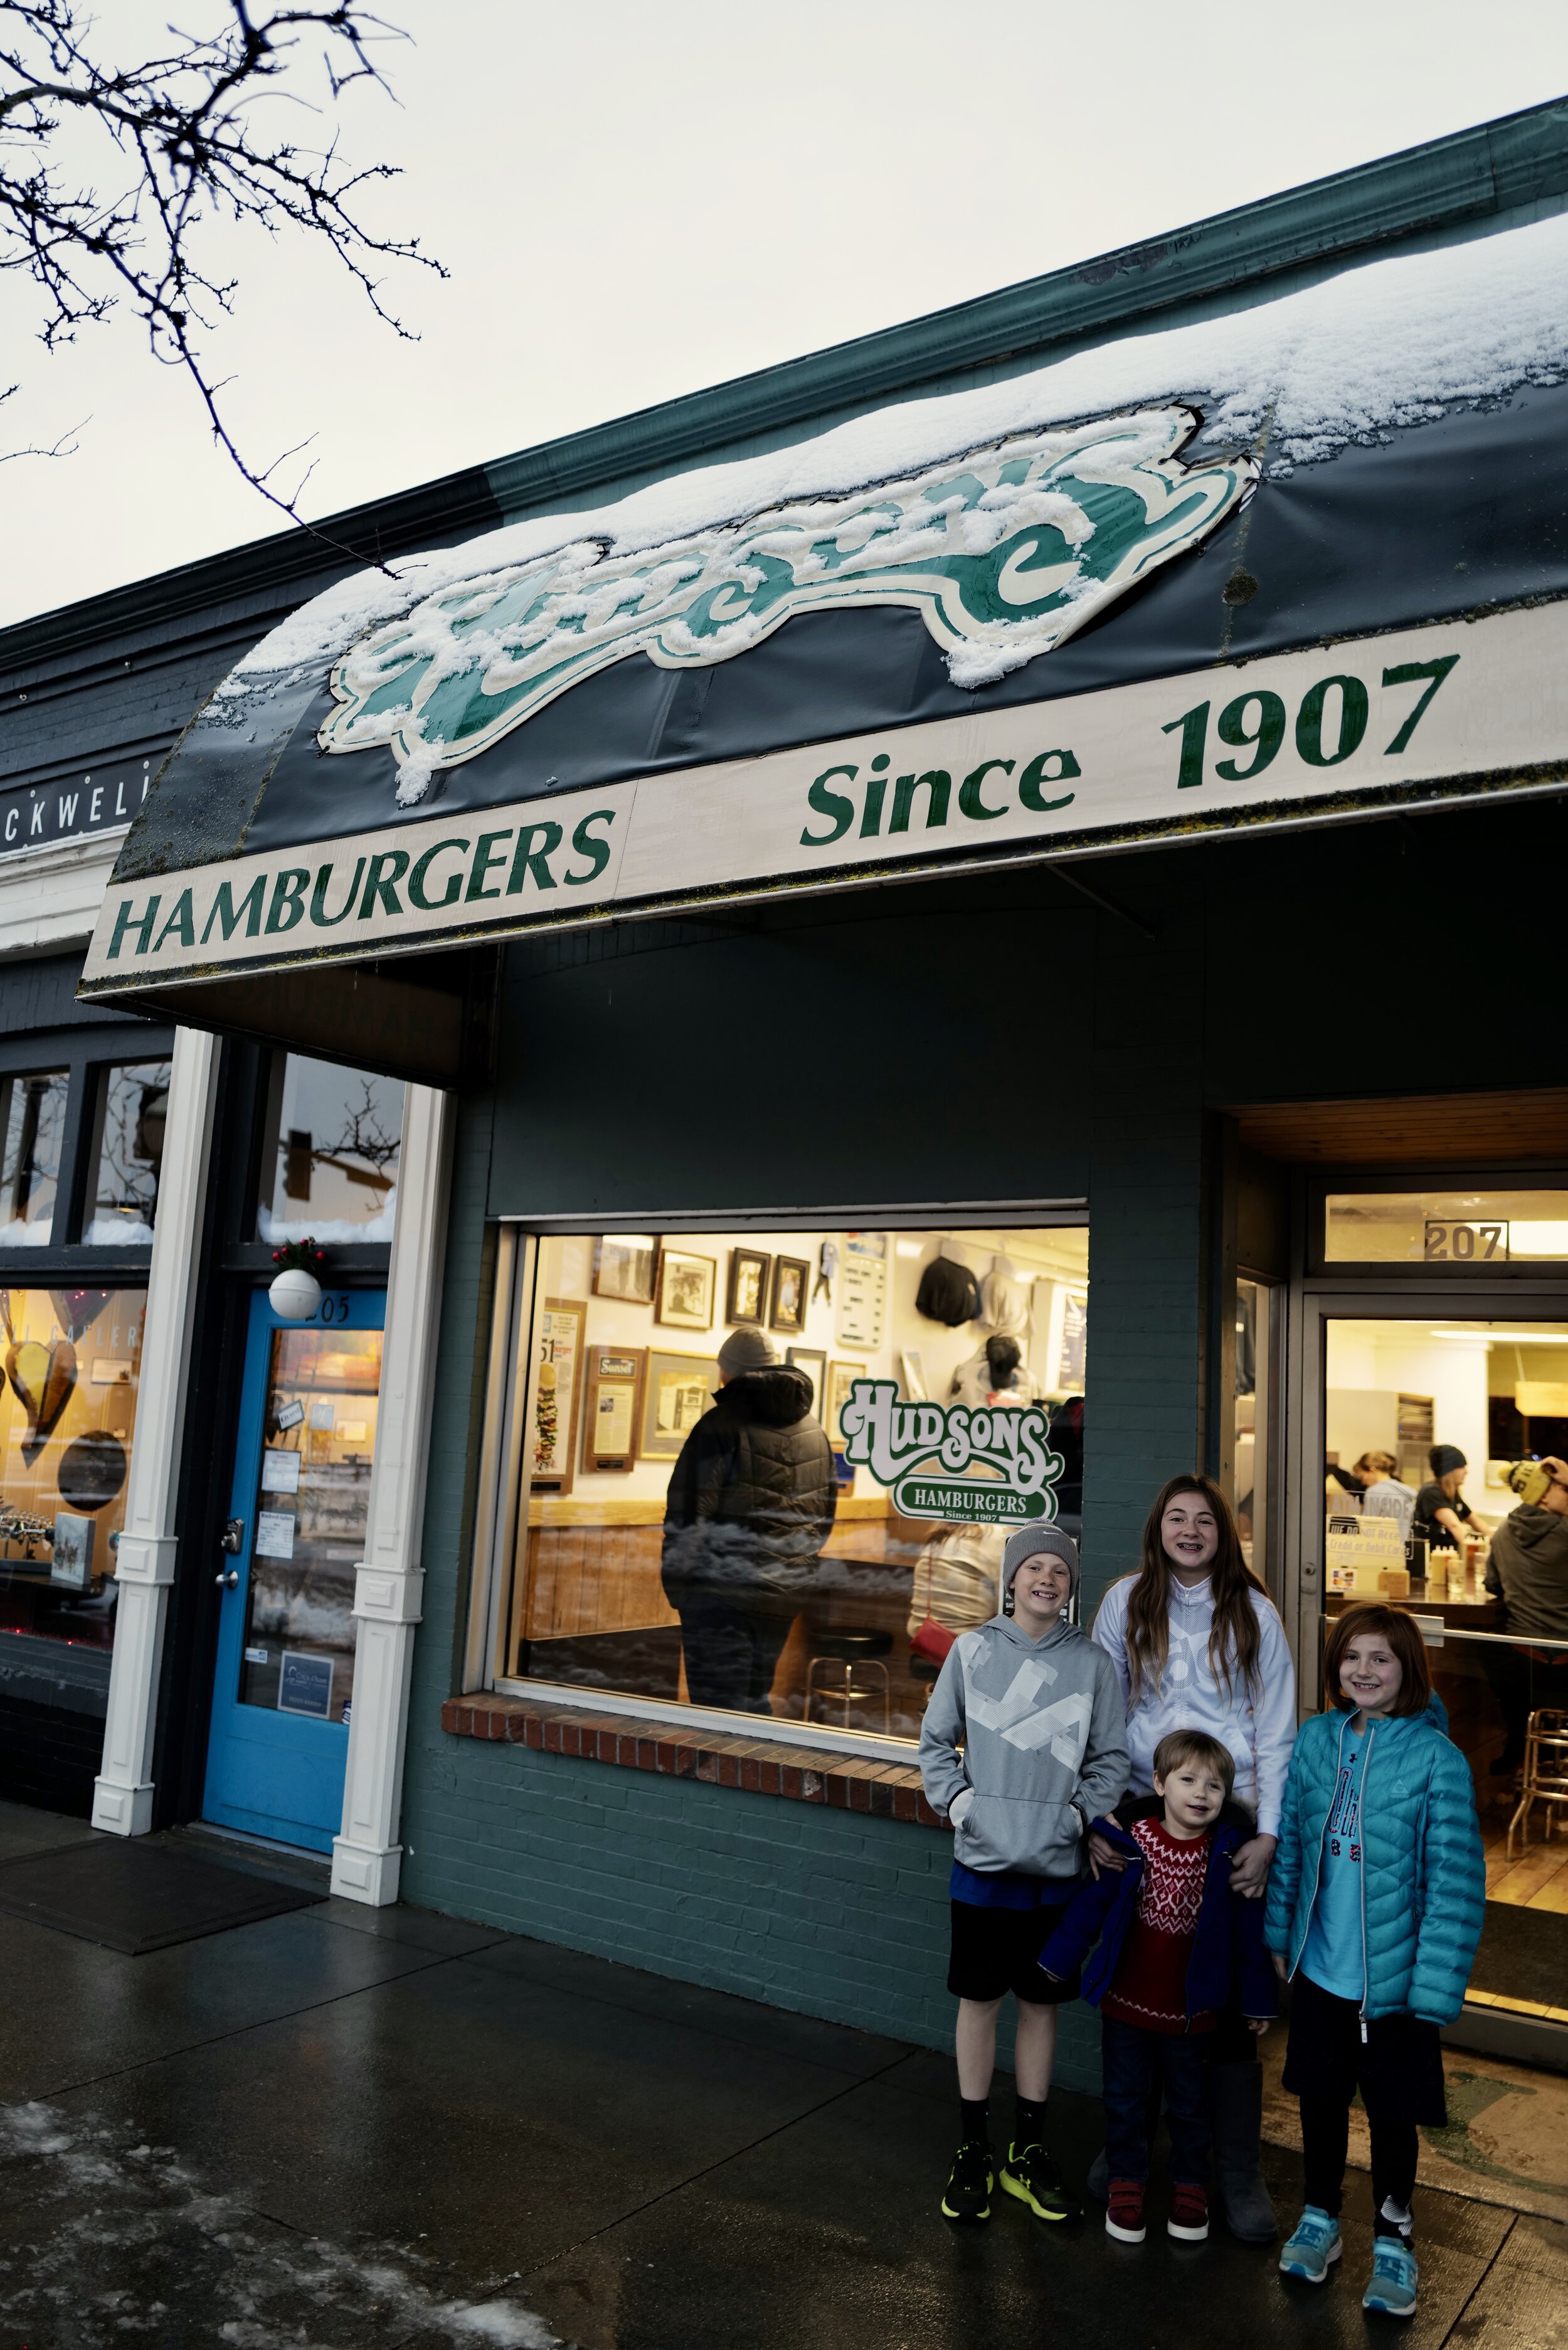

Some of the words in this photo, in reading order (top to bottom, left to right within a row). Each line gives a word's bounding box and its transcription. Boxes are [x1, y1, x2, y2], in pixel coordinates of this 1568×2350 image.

[799, 749, 1081, 847] Since
[1161, 653, 1460, 789] 1907
[106, 810, 616, 960] HAMBURGERS
[1425, 1226, 1502, 1260] 207
[305, 1295, 349, 1323] 05
[914, 1489, 1027, 1513] HAMBURGERS
[946, 1511, 972, 1520] Since
[975, 1513, 997, 1522] 1907
[1378, 1529, 1409, 1544] Accep
